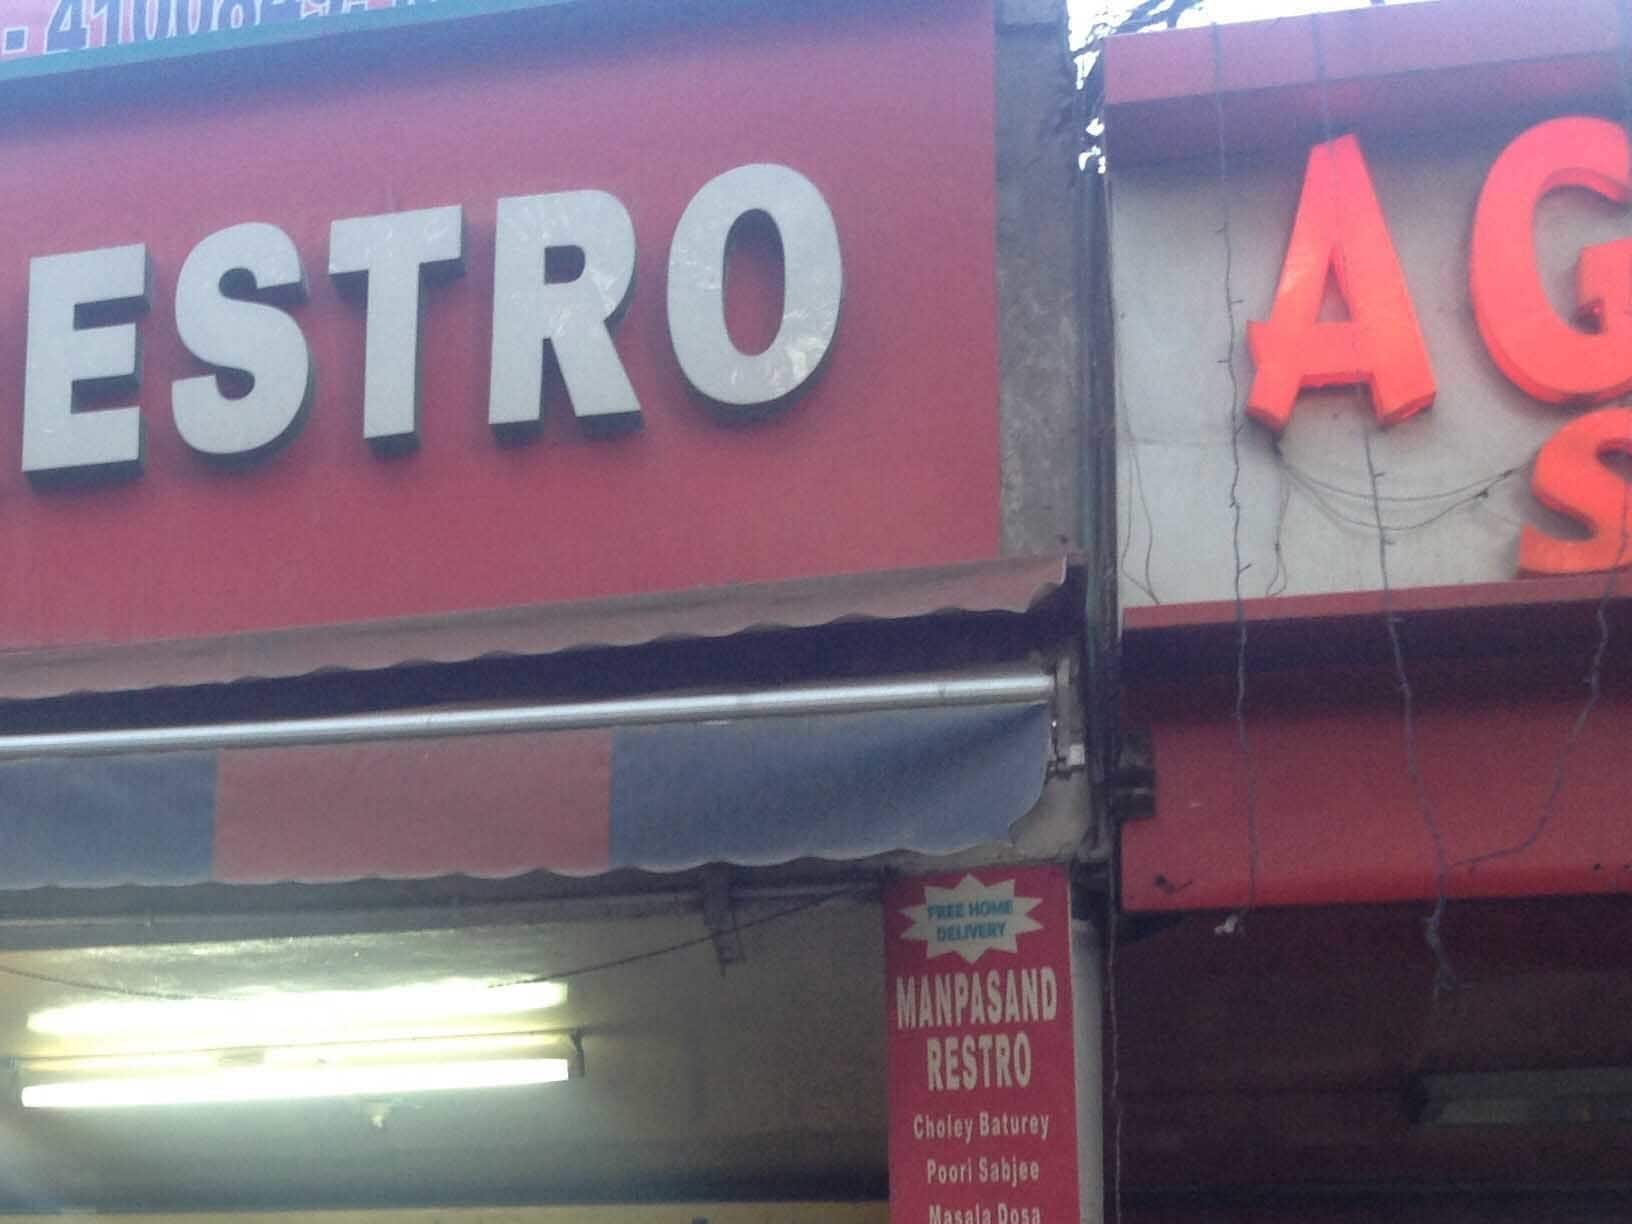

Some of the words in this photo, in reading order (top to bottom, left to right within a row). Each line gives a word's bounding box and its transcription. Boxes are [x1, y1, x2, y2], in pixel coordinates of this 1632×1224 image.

[928, 904, 964, 919] FREE
[970, 900, 1013, 917] HOME
[937, 921, 1006, 941] DELIVERY
[896, 966, 1058, 1029] MANPASAND
[927, 1031, 1032, 1092] RESTRO
[914, 1114, 974, 1144] Choley
[979, 1112, 1049, 1140] Baturey
[927, 1158, 973, 1185] Poori
[979, 1156, 1040, 1187] Sabjee
